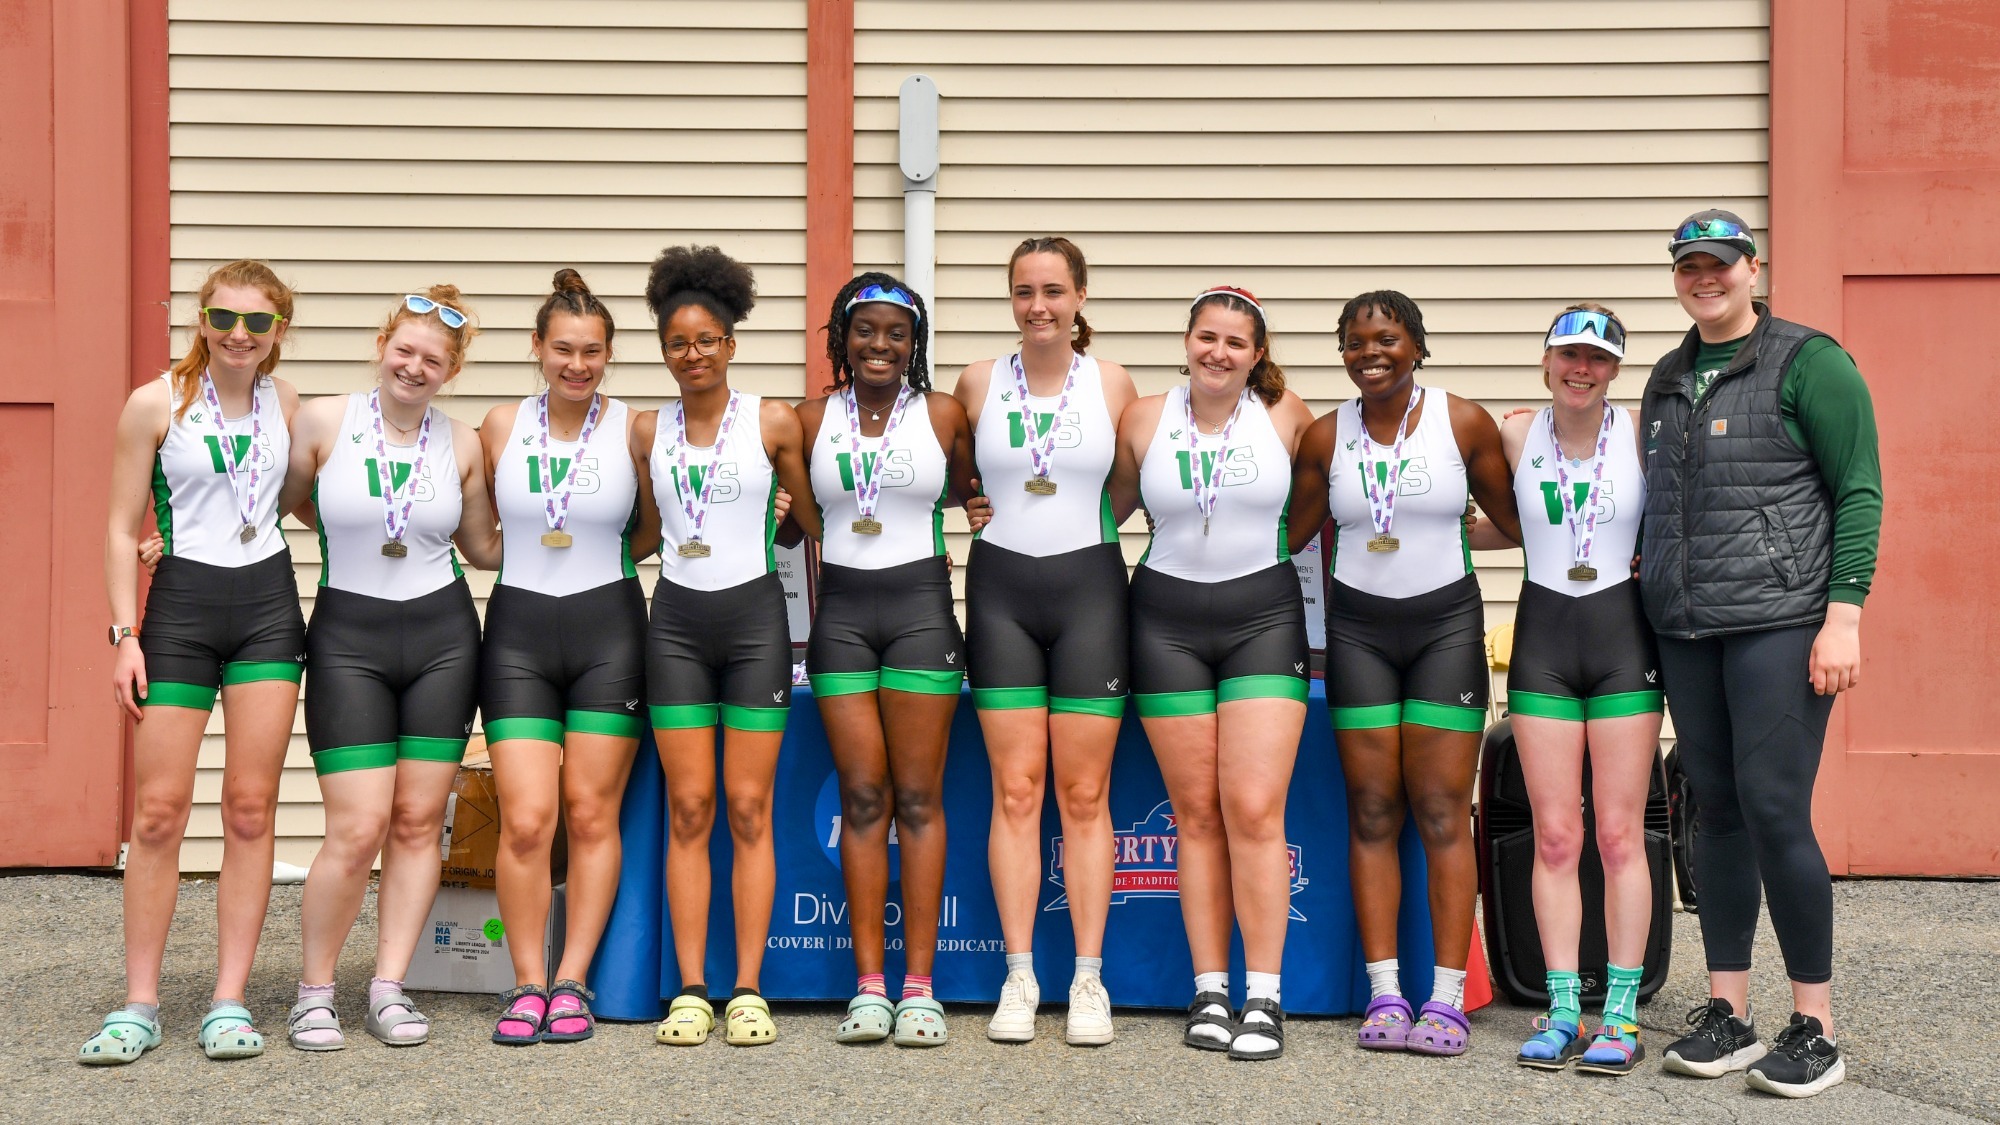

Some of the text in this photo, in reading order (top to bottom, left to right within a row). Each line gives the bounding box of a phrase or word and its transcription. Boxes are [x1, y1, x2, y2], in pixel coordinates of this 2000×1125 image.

[1303, 596, 1316, 605] PION
[449, 867, 480, 877] ORIGIN:
[483, 869, 496, 879] JO
[764, 936, 825, 950] COVER
[937, 939, 1007, 952] EDICATE
